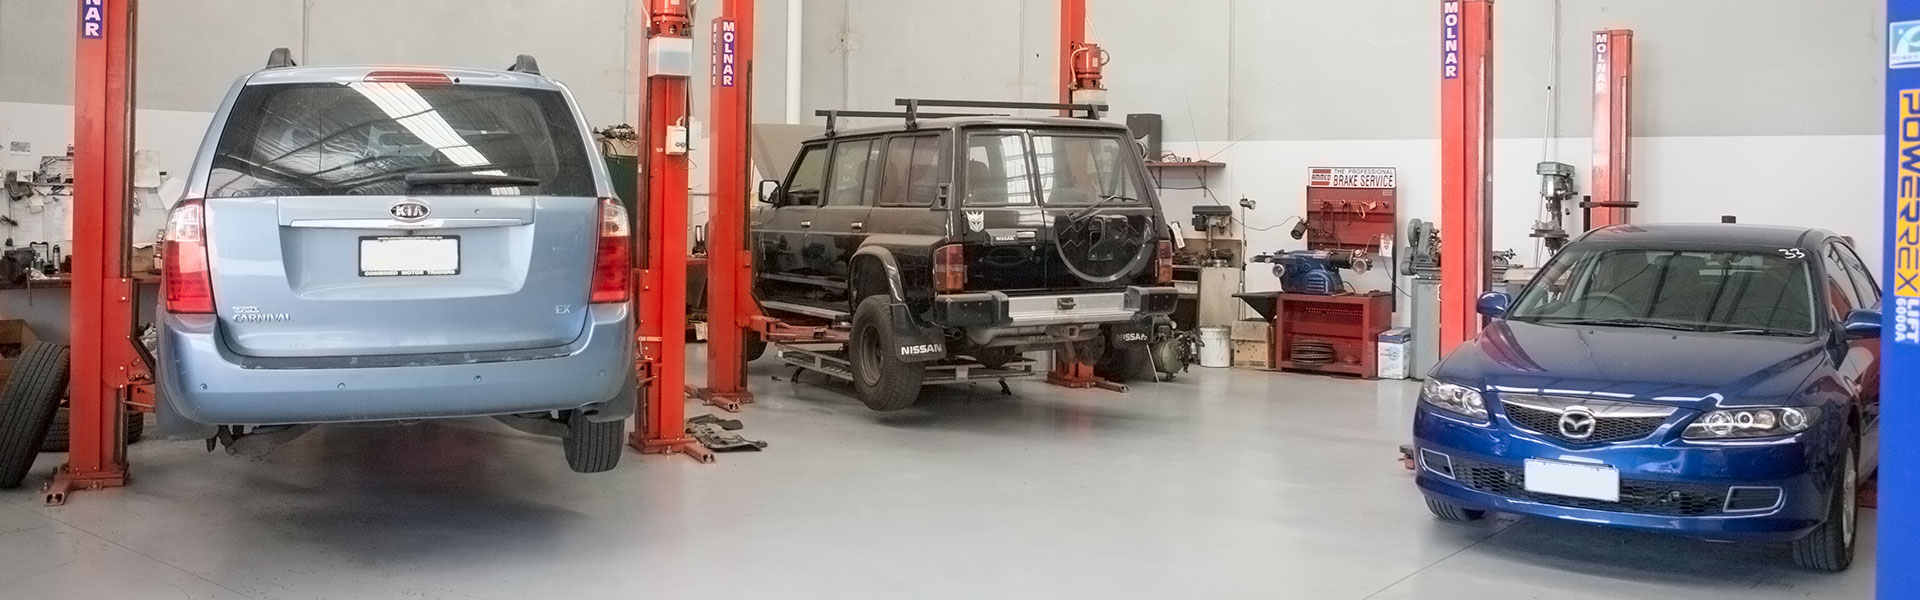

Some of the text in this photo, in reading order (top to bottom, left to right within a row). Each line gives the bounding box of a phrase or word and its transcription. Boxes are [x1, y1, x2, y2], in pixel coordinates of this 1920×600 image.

[1444, 2, 1458, 77] MOLNAR
[723, 21, 735, 86] MOLNAR
[1596, 34, 1607, 93] MOLNAR
[1333, 174, 1393, 187] BRAKE SERVICE
[396, 205, 423, 216] KIA
[1778, 248, 1805, 259] 33
[556, 305, 571, 314] EX
[232, 313, 291, 323] CARNIVAL
[1907, 298, 1920, 344] LIFT
[901, 343, 942, 355] NISSAN
